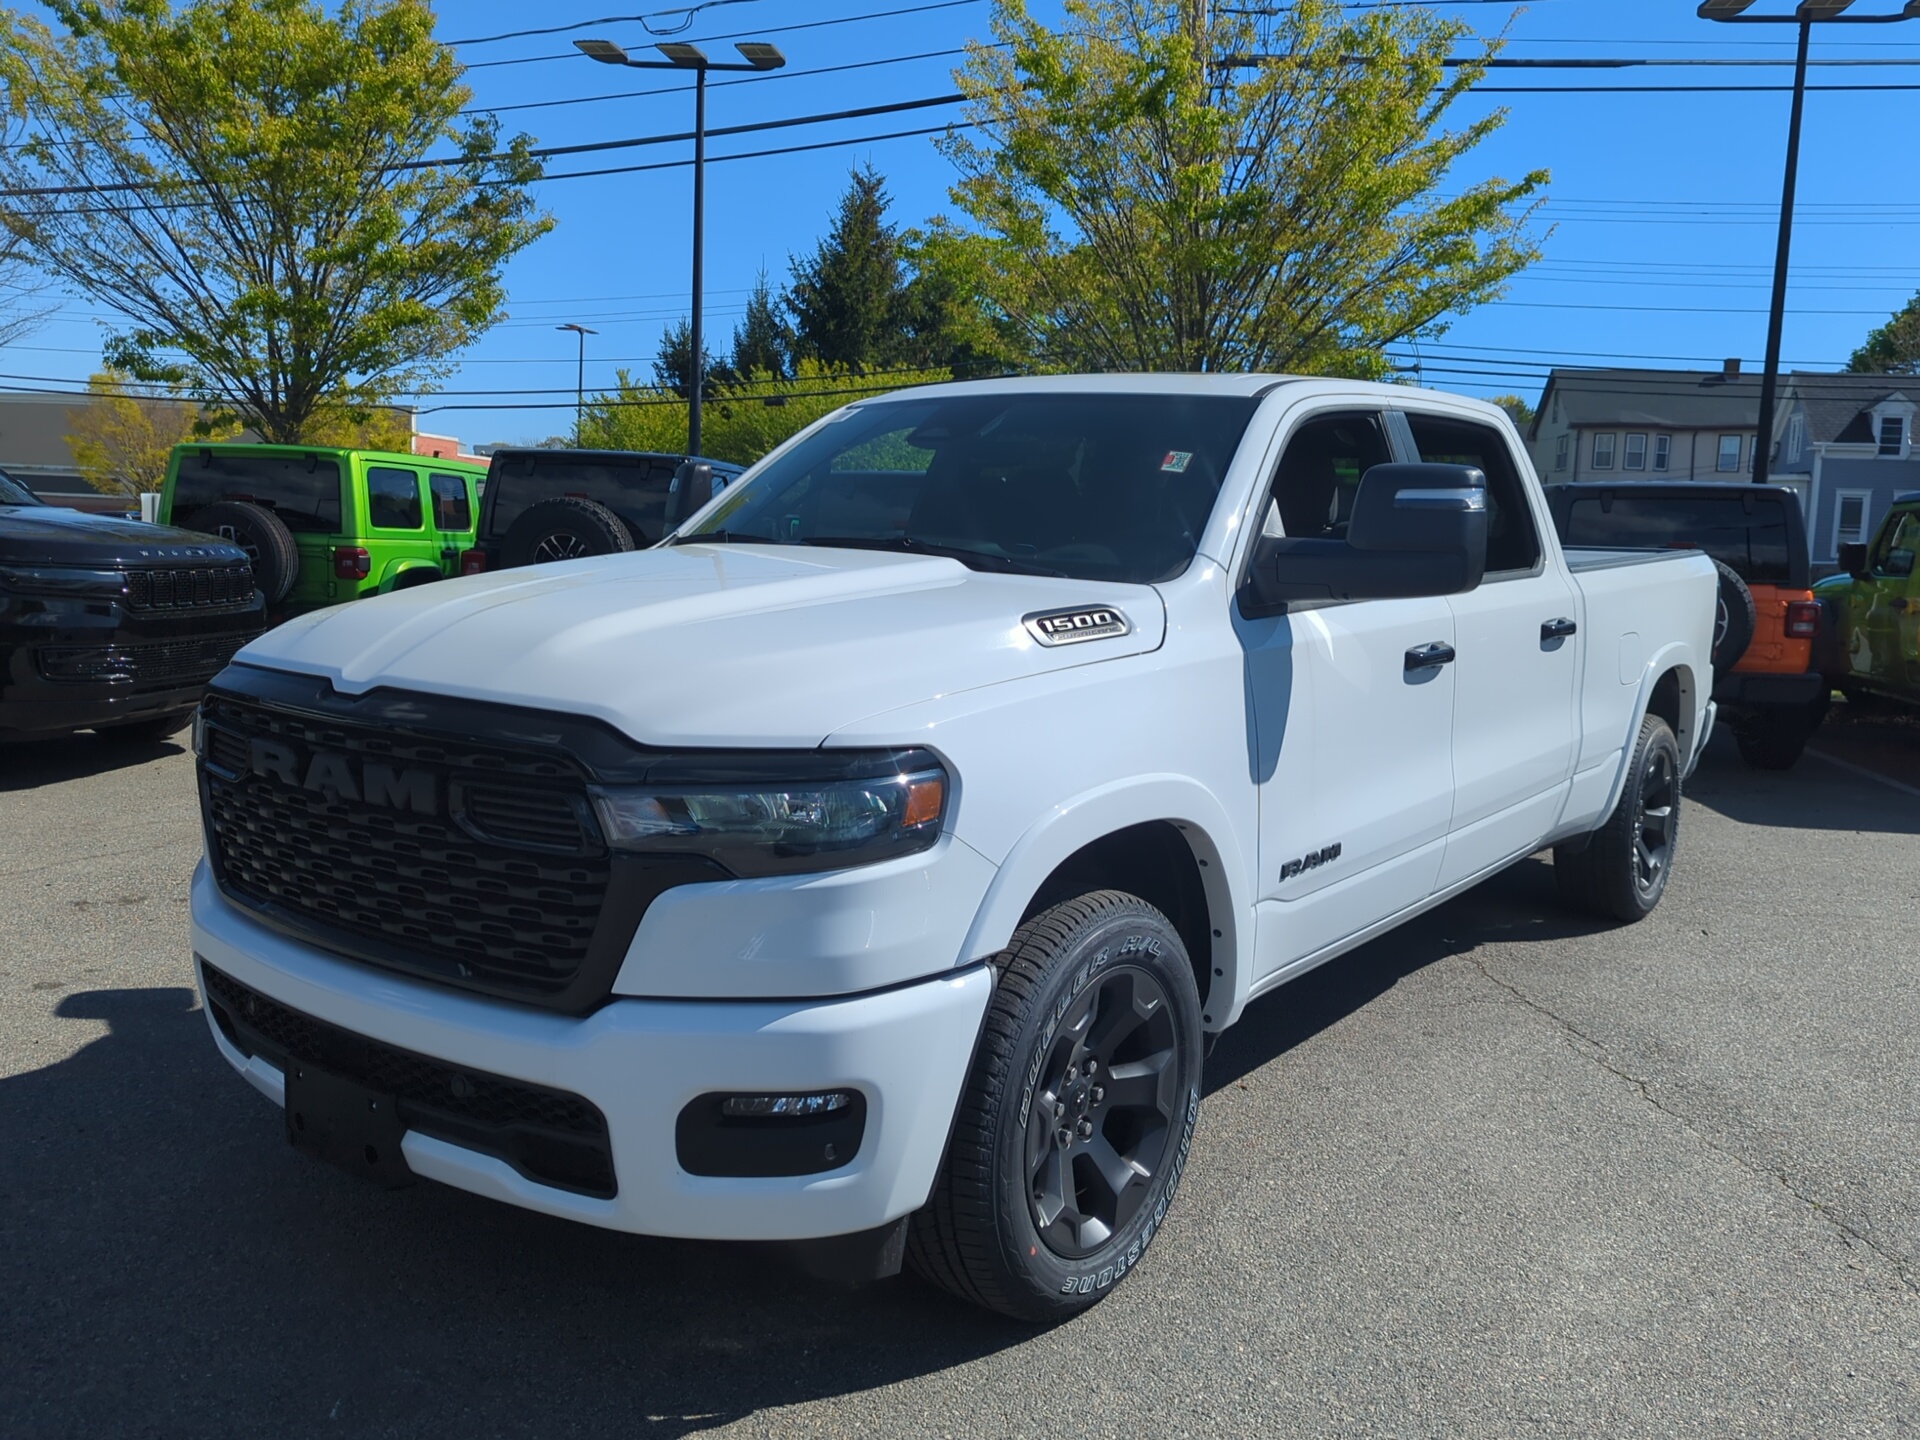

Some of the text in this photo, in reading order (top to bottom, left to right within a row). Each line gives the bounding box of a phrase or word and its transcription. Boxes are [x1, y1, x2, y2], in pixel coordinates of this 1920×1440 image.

[1039, 611, 1113, 633] 1500
[250, 737, 436, 816] RAM
[1279, 841, 1342, 883] RAM
[1019, 935, 1161, 1128] DUELER H/L
[1062, 1088, 1198, 1294] BRIDGESTONE
